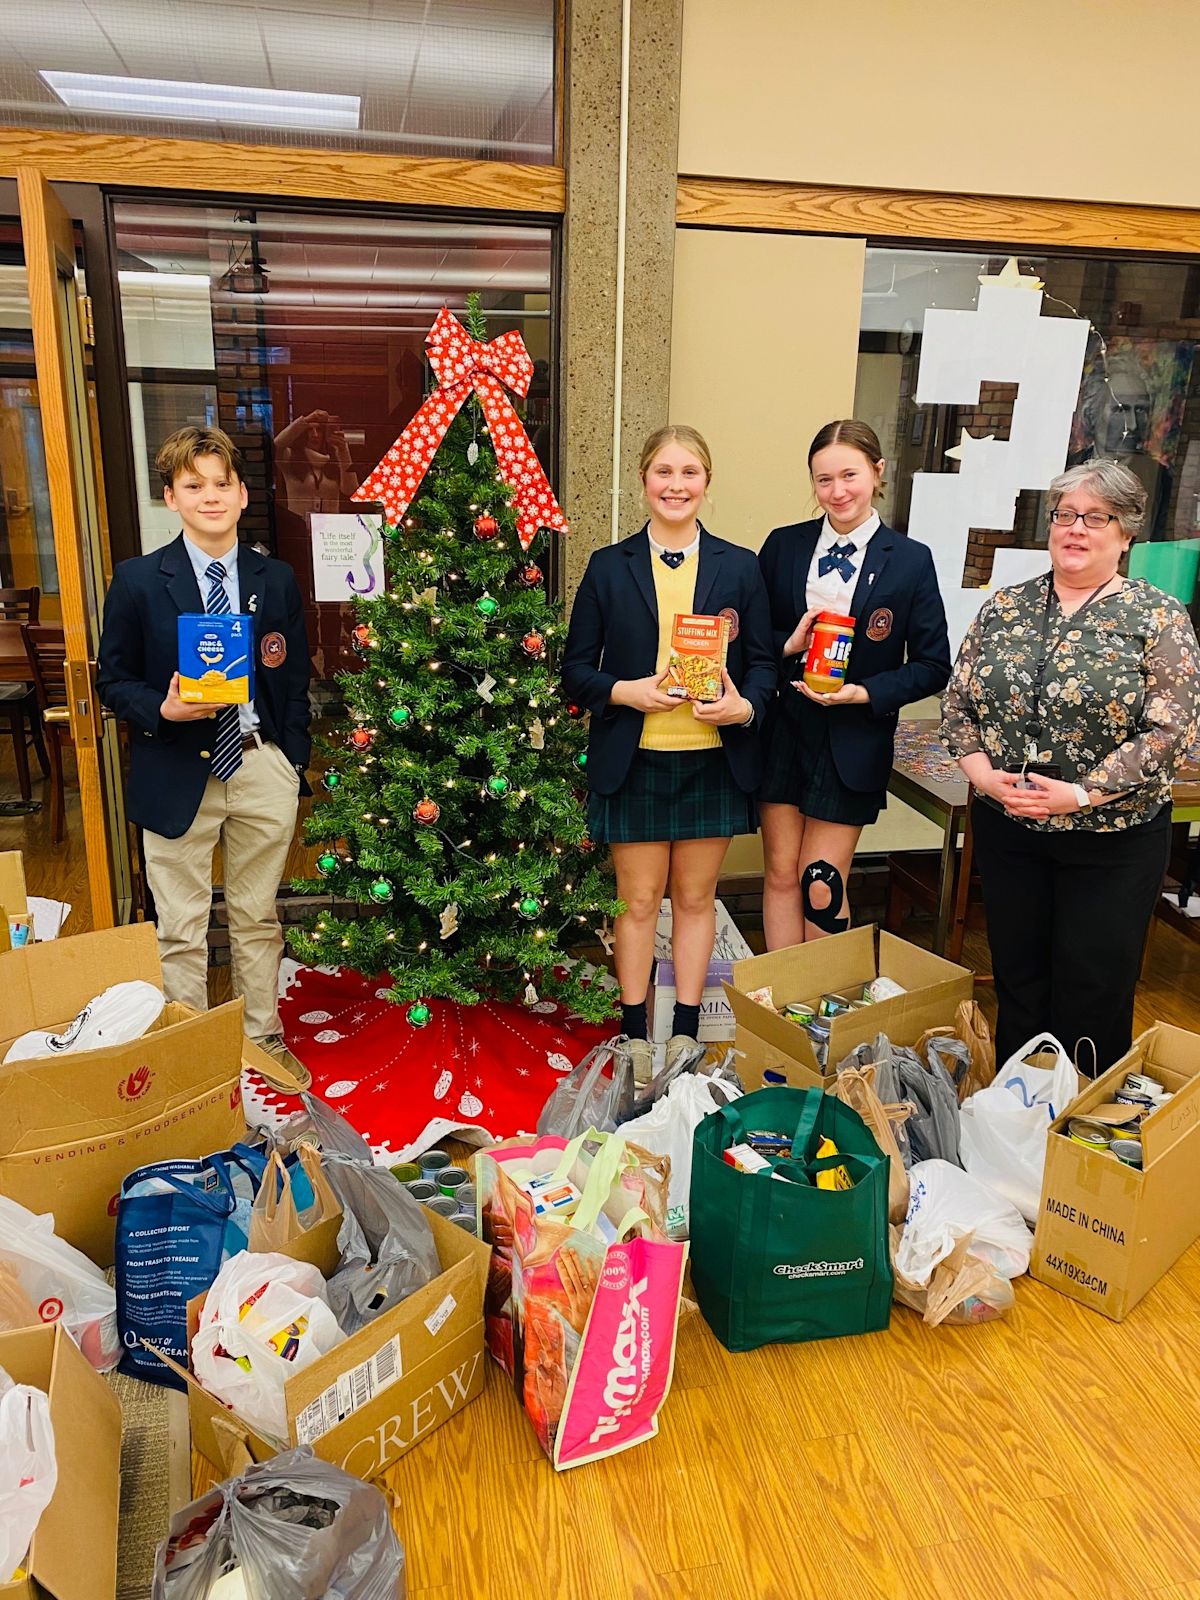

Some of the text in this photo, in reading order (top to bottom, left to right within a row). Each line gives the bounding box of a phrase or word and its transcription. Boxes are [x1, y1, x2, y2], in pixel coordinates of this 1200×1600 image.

[338, 532, 356, 540] itself
[321, 554, 338, 562] fairy
[231, 621, 242, 632] 4
[677, 626, 718, 638] STUFFING MIX
[683, 639, 710, 647] CHICKEN
[823, 640, 853, 660] Jif
[699, 1001, 732, 1013] MIN
[33, 1092, 225, 1165] VENDING & FOODSERVICE
[1046, 1197, 1126, 1247] MADE IN CHINA
[135, 1227, 167, 1237] COLLECTED
[145, 1258, 162, 1266] TRASH
[773, 1257, 864, 1275] CheckSmart
[603, 1265, 626, 1277] 100%
[788, 1270, 846, 1279] checksmart.com
[1046, 1253, 1107, 1296] 44X19X34CM
[126, 1290, 150, 1300] CHANGE
[150, 1290, 169, 1299] STARTS
